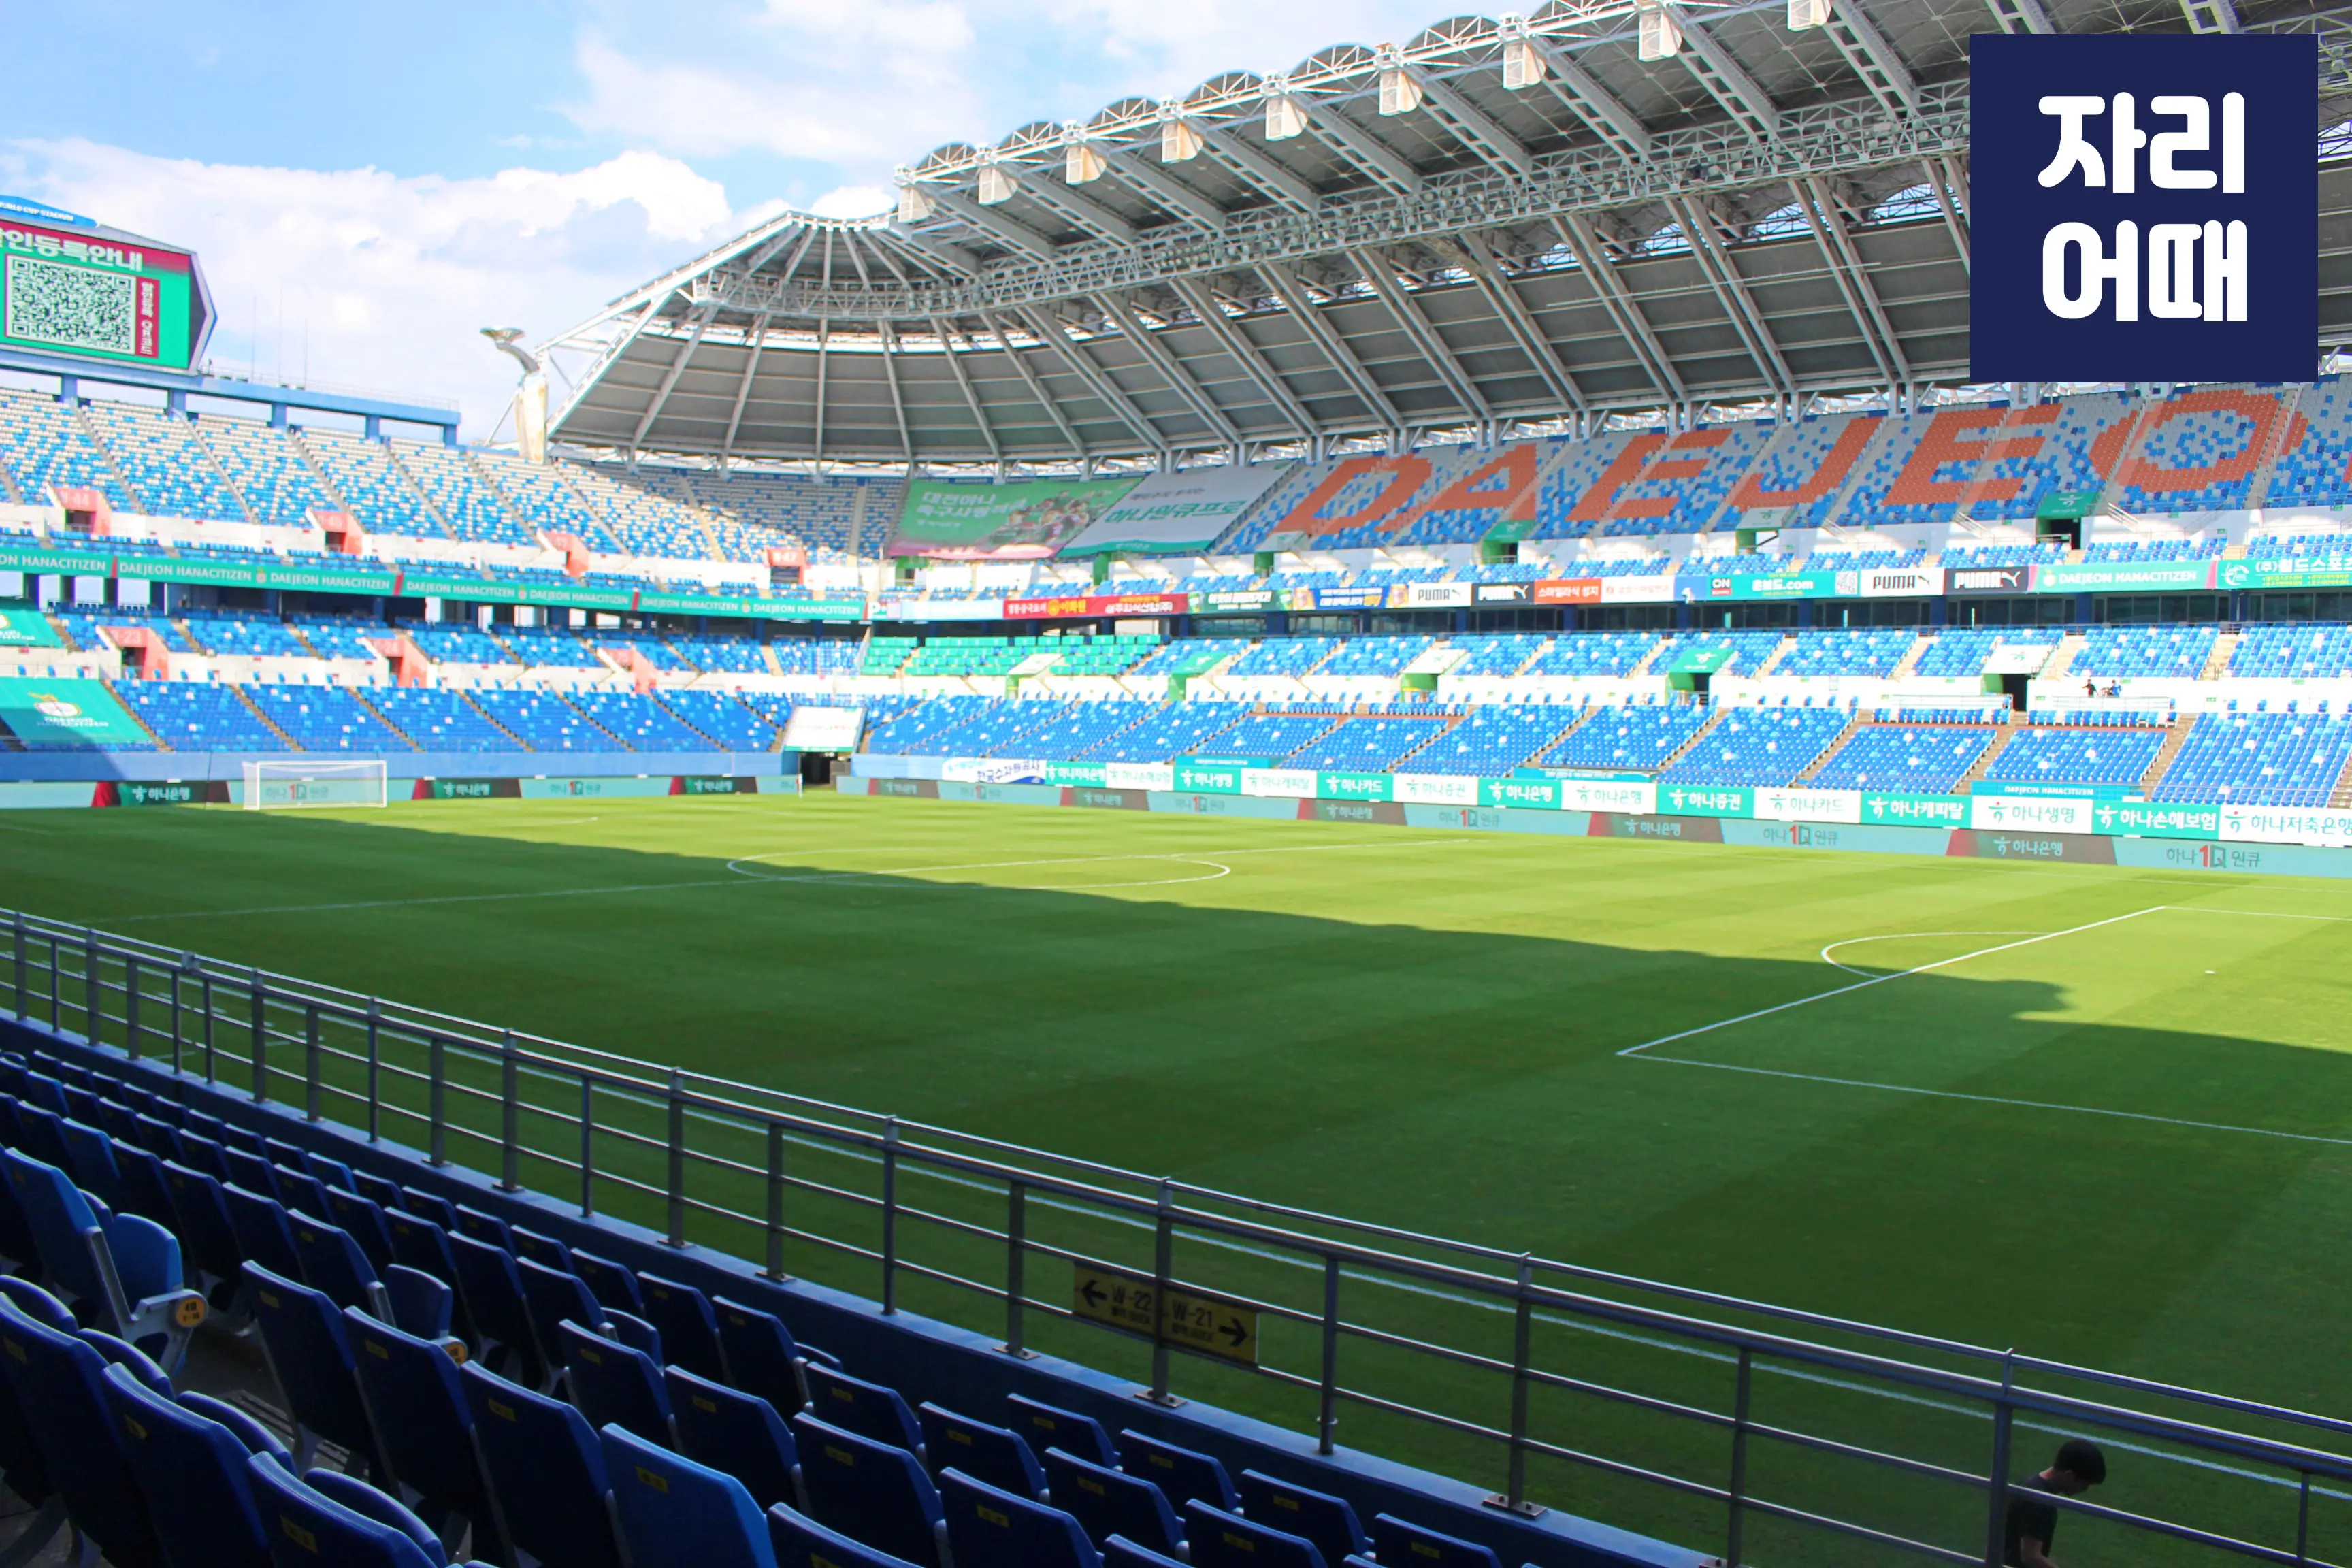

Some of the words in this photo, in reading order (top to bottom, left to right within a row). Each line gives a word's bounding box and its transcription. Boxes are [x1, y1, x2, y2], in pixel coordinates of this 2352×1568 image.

[1275, 389, 2352, 533] DAEJEO
[1105, 500, 1247, 523] 하나원큐프로
[22, 555, 105, 572] HANACITIZEN
[120, 562, 173, 577] DAEJEON
[176, 566, 252, 581] HANACITIZEN
[271, 572, 318, 586] DAEJEON
[322, 576, 389, 589] HANACITIZEN
[1712, 578, 1731, 589] ON
[1873, 575, 1916, 589] PUMA
[1954, 570, 2003, 589] PUMA
[2059, 572, 2112, 585] DAEJEON
[2115, 570, 2198, 583] HANACITIZEN
[407, 581, 451, 594] DAEJEON
[453, 585, 515, 598] HANACITIZEN
[529, 589, 570, 602] DAEJEON
[572, 592, 630, 605] HANACITIZEN
[1418, 589, 1450, 601] PUMA
[1478, 585, 1516, 601] PUMA
[642, 597, 679, 610] DAEJEON
[681, 600, 738, 612] HANACITIZEN
[753, 603, 795, 615] DAEJEON
[798, 605, 860, 615] HANACITIZEN
[1058, 766, 1106, 783] 하나저축은행
[1195, 771, 1232, 789] 하나생명
[148, 786, 191, 801] 하나은행
[1342, 778, 1383, 794] 하나카드
[1422, 783, 1466, 798] 하나증권
[1507, 784, 1552, 802] 하나은행
[2042, 787, 2094, 796] HANACITIZEN
[1595, 788, 1642, 805] 하나은행
[1688, 791, 1741, 810] 하나증권
[1791, 794, 1845, 812] 하나카드
[1339, 806, 1373, 819] 하나은행
[1439, 811, 1459, 823] 하나
[1890, 800, 1964, 820] 하나캐피탈
[2012, 804, 2075, 823] 하나생명
[1640, 821, 1681, 836] 하나은행
[2120, 810, 2217, 831] 하나손해보험
[2251, 815, 2352, 836] 하나저축은행
[1763, 827, 1787, 843] 하나
[1790, 825, 1812, 845] 1Q
[1815, 831, 1838, 846] 원큐
[2012, 841, 2063, 857] 하나은행
[2166, 848, 2197, 865] 하나
[2199, 845, 2227, 868] 1Q
[2231, 851, 2261, 868] 원큐
[1111, 1284, 1153, 1312] W-22
[1171, 1299, 1213, 1328] W-21
